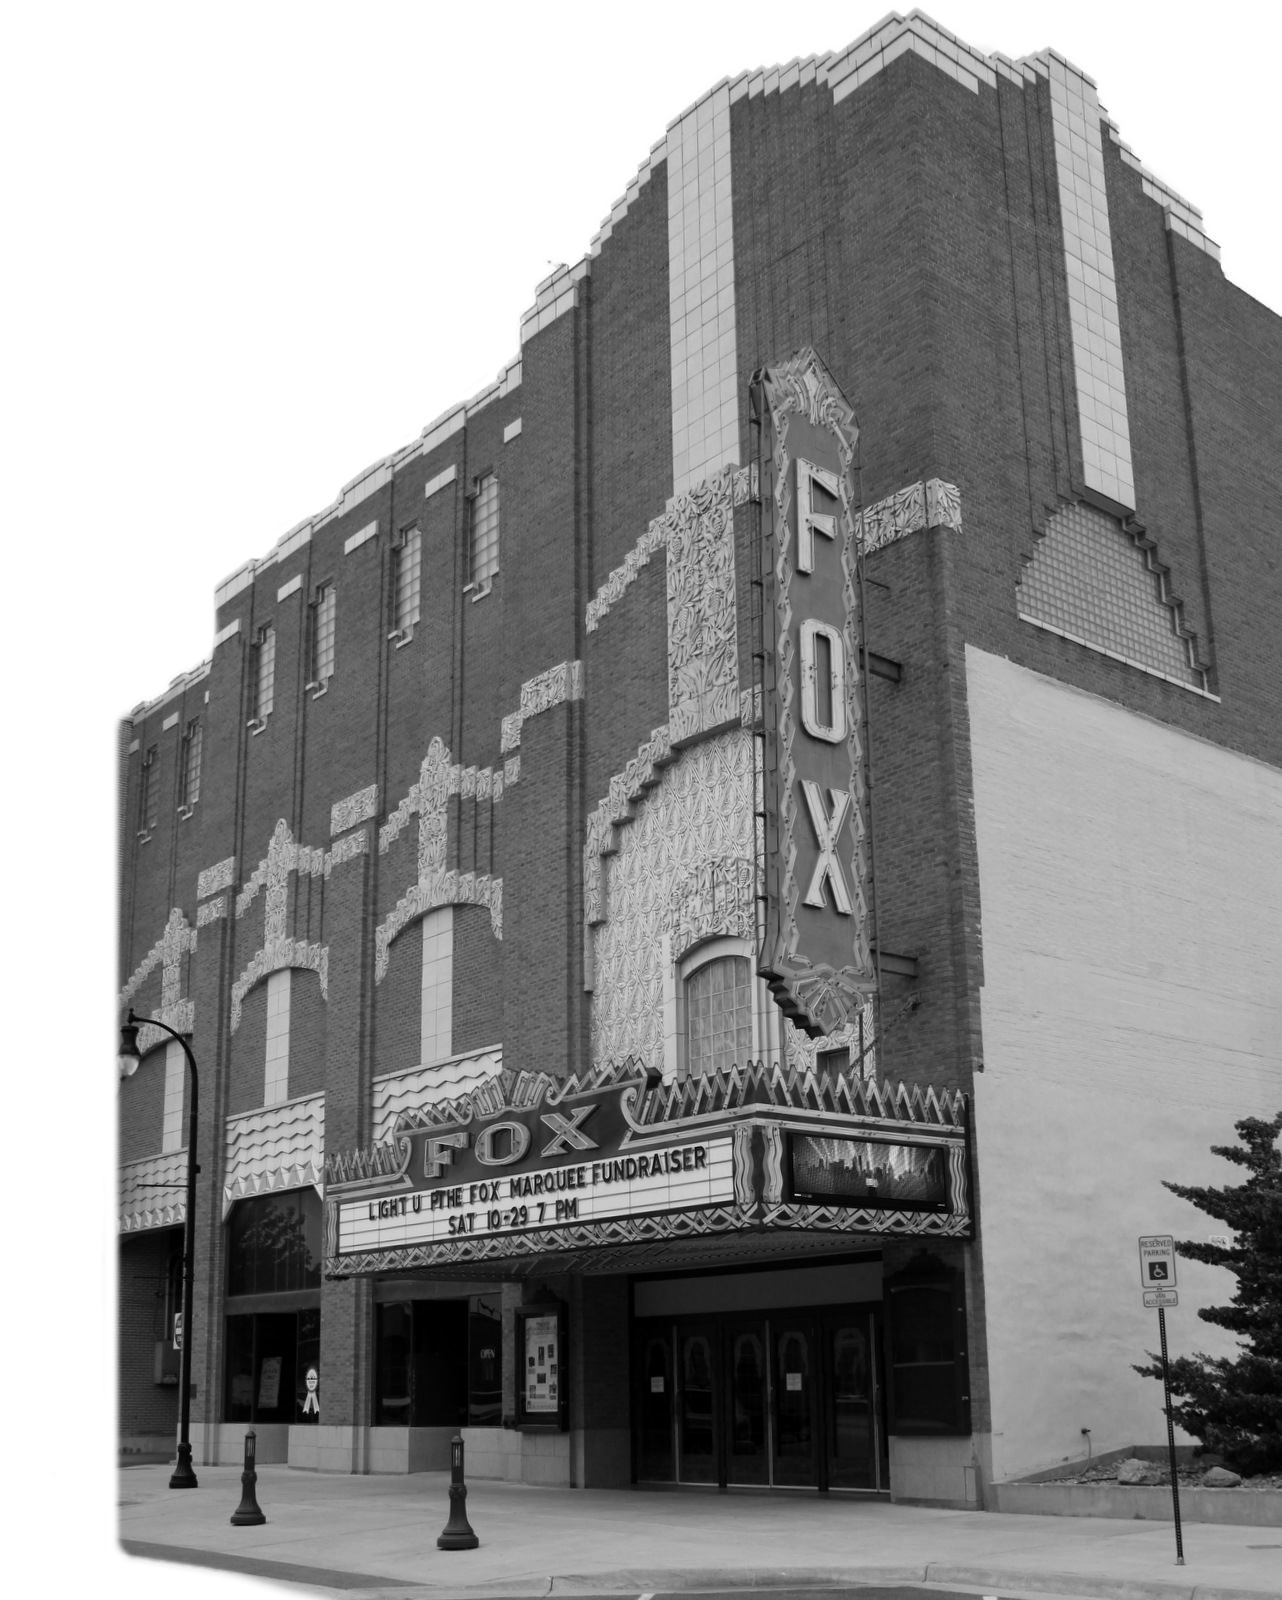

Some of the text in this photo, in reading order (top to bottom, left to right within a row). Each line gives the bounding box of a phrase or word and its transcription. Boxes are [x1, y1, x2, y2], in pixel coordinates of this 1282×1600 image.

[795, 457, 853, 916] FOX
[423, 1103, 600, 1179] FOX
[368, 1196, 407, 1221] LIGHT
[469, 1180, 501, 1205] FOX
[509, 1165, 586, 1199] MARQUEE
[591, 1145, 708, 1187] FUNDRAISER
[448, 1197, 580, 1235] SAT 10-29 7 PM
[1141, 1239, 1172, 1248] RESERVED
[1143, 1249, 1171, 1257] PARKING
